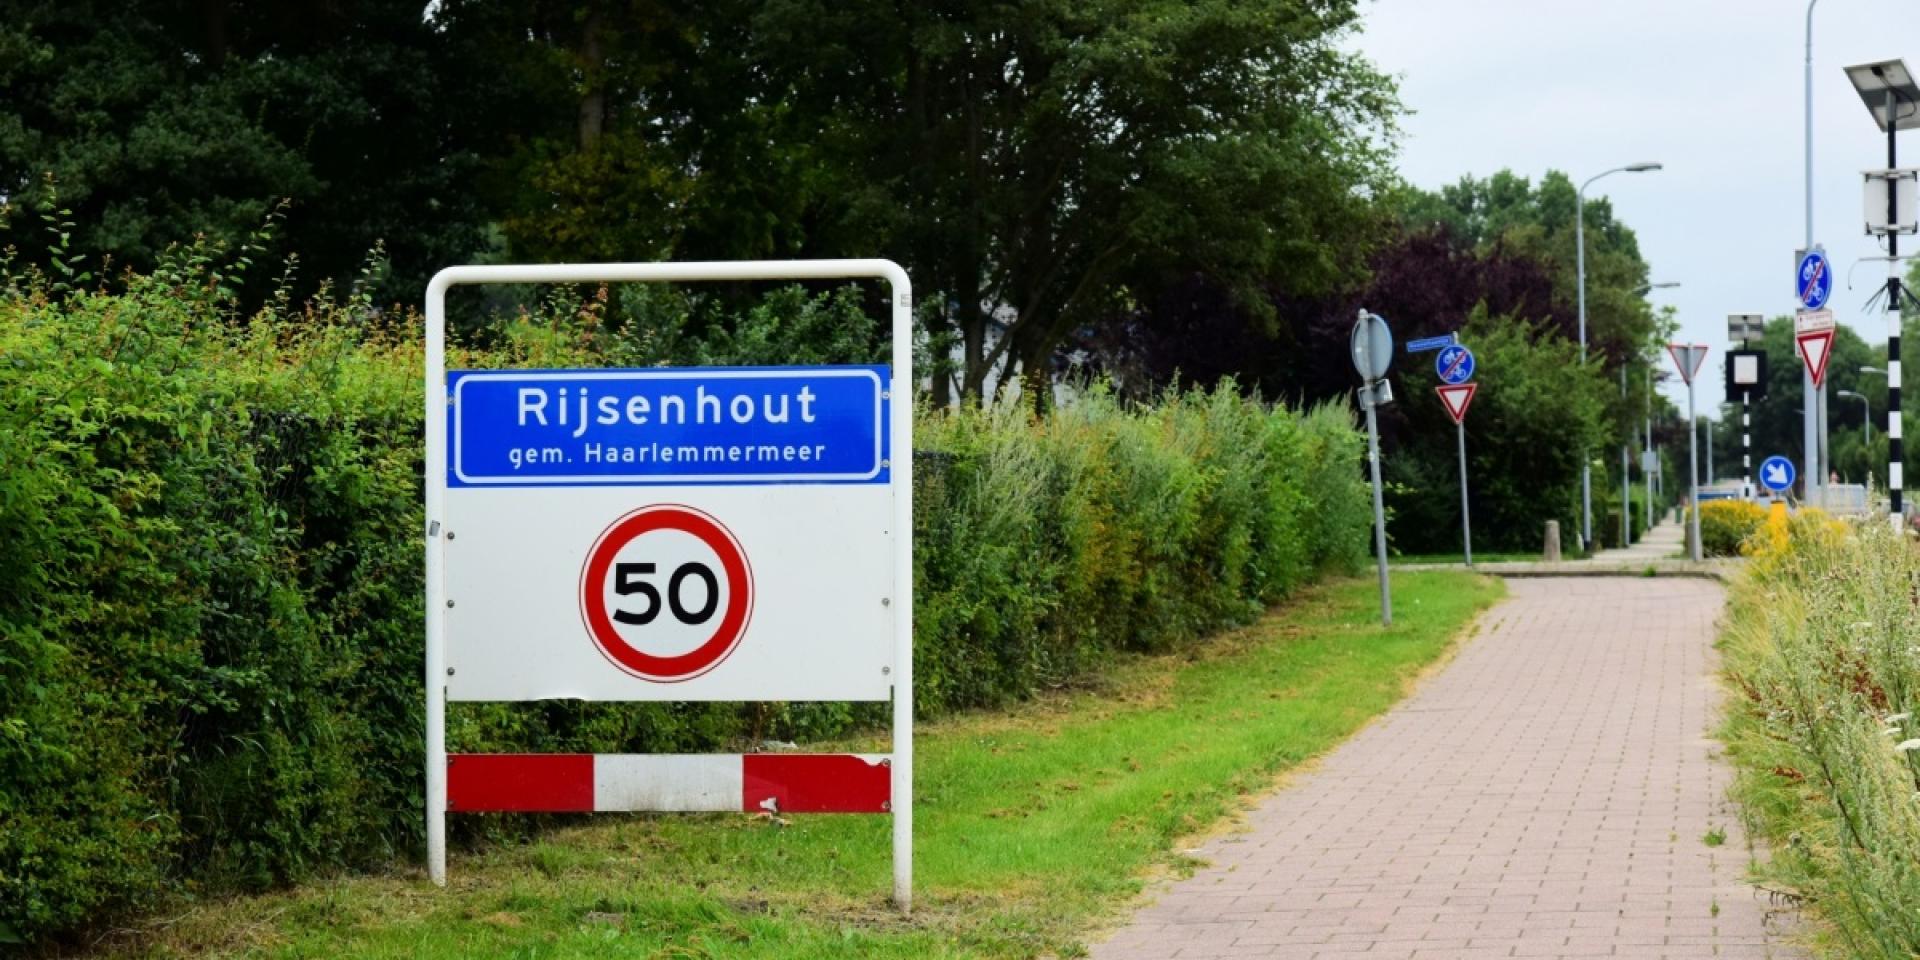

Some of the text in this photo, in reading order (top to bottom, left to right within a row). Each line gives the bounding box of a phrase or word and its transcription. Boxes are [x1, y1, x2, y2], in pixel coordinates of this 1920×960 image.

[518, 385, 817, 437] Rijsenhout
[509, 443, 826, 469] gem. Haarlemmermeer
[613, 562, 719, 626] 50
